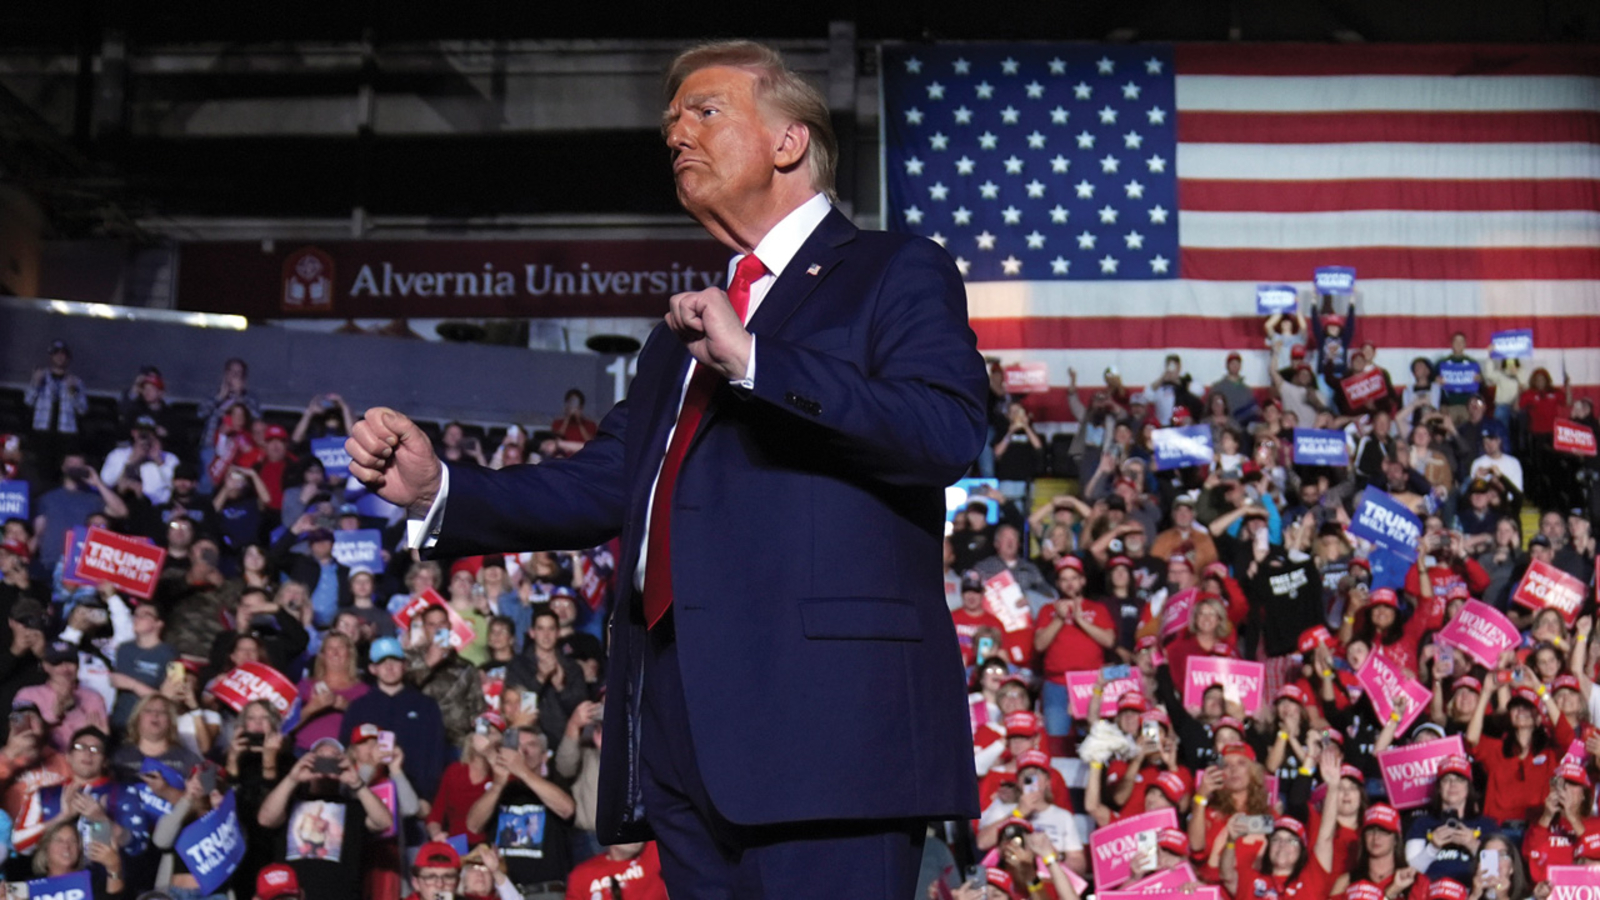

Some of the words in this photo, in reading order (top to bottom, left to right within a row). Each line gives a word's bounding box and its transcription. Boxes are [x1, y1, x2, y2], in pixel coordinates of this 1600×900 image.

[350, 262, 516, 297] Alvernia
[525, 263, 726, 295] University
[89, 540, 156, 572] TRUMP
[1459, 610, 1512, 649] WOMEN
[229, 667, 290, 711] TRUMP
[1386, 754, 1447, 783] WOME
